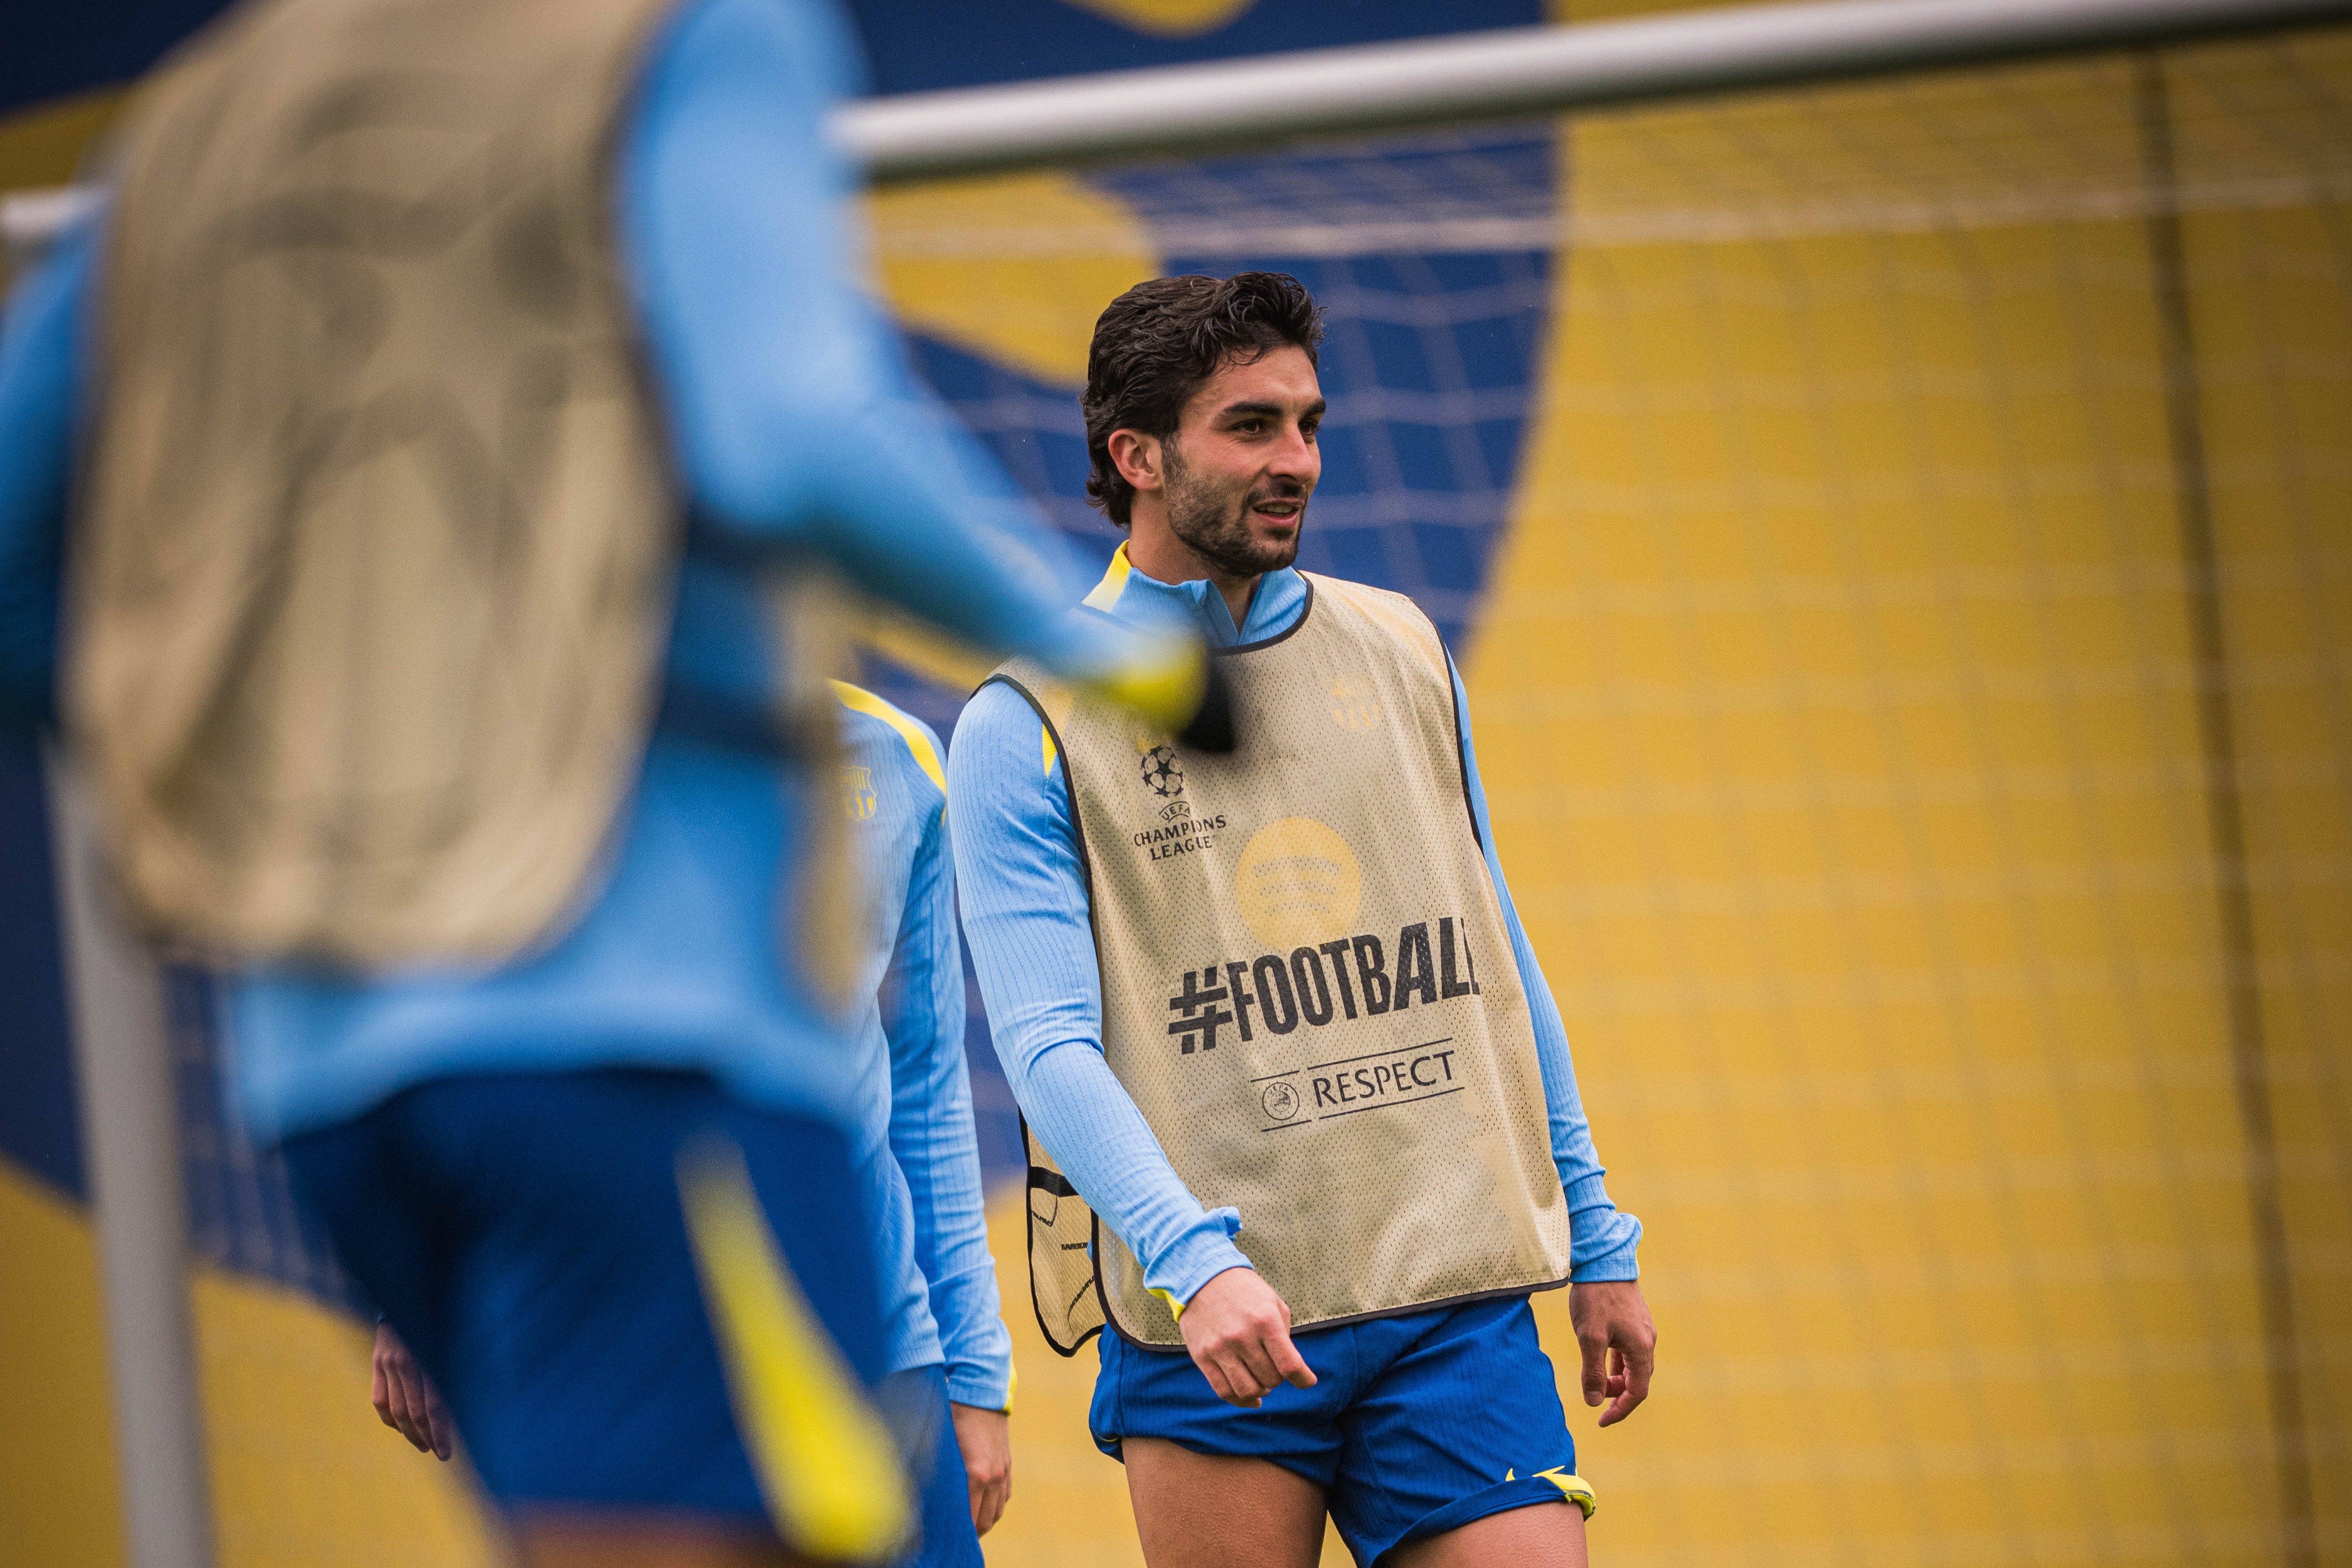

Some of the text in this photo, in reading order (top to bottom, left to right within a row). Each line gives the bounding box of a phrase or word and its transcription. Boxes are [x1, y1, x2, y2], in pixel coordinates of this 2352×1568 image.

[1162, 804, 1190, 820] UEFA
[1134, 815, 1227, 847] CHAMPIONS
[1150, 836, 1212, 861] LEAGUE
[1268, 1085, 1289, 1095] UEFA
[1312, 1050, 1455, 1107] RESPECT
